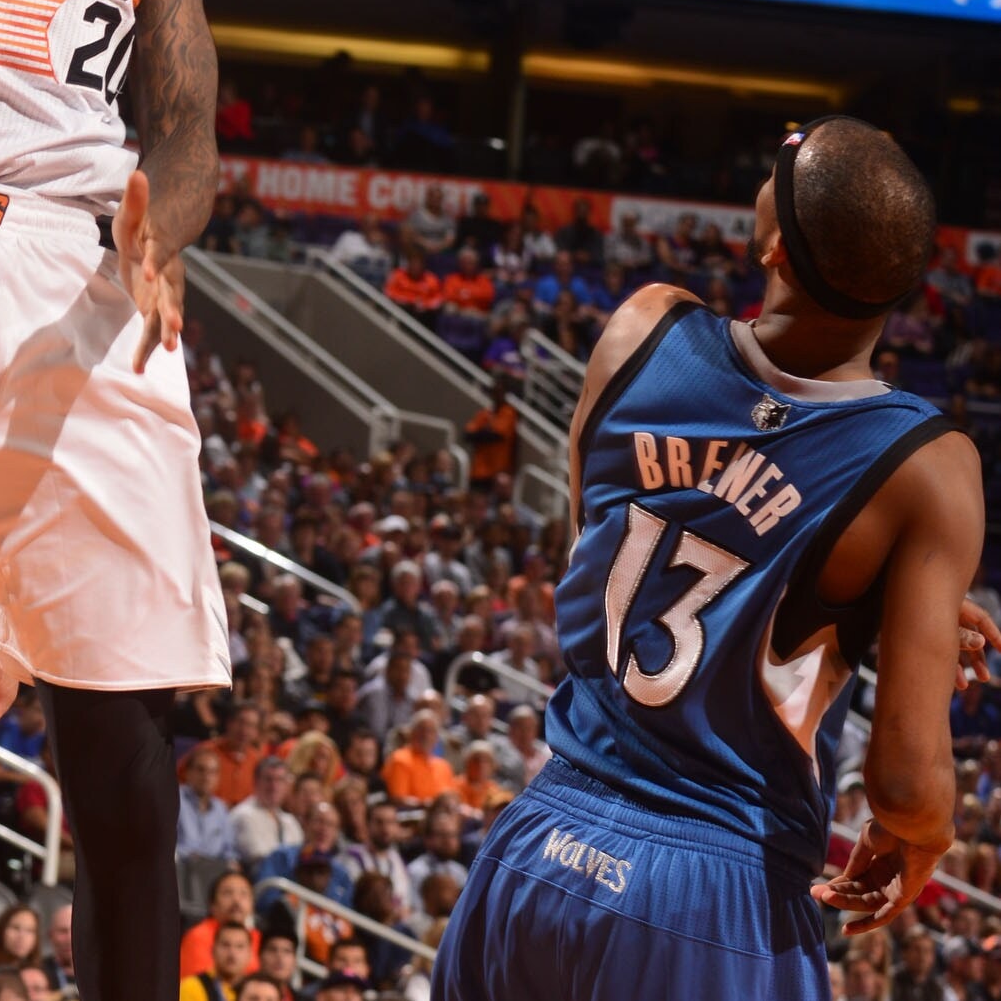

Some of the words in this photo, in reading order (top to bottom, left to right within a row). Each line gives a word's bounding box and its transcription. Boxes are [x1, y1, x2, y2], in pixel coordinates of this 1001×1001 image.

[258, 162, 358, 207] HOME
[633, 432, 802, 536] BREWER
[605, 503, 751, 707] 13
[543, 828, 632, 893] WOLVES
